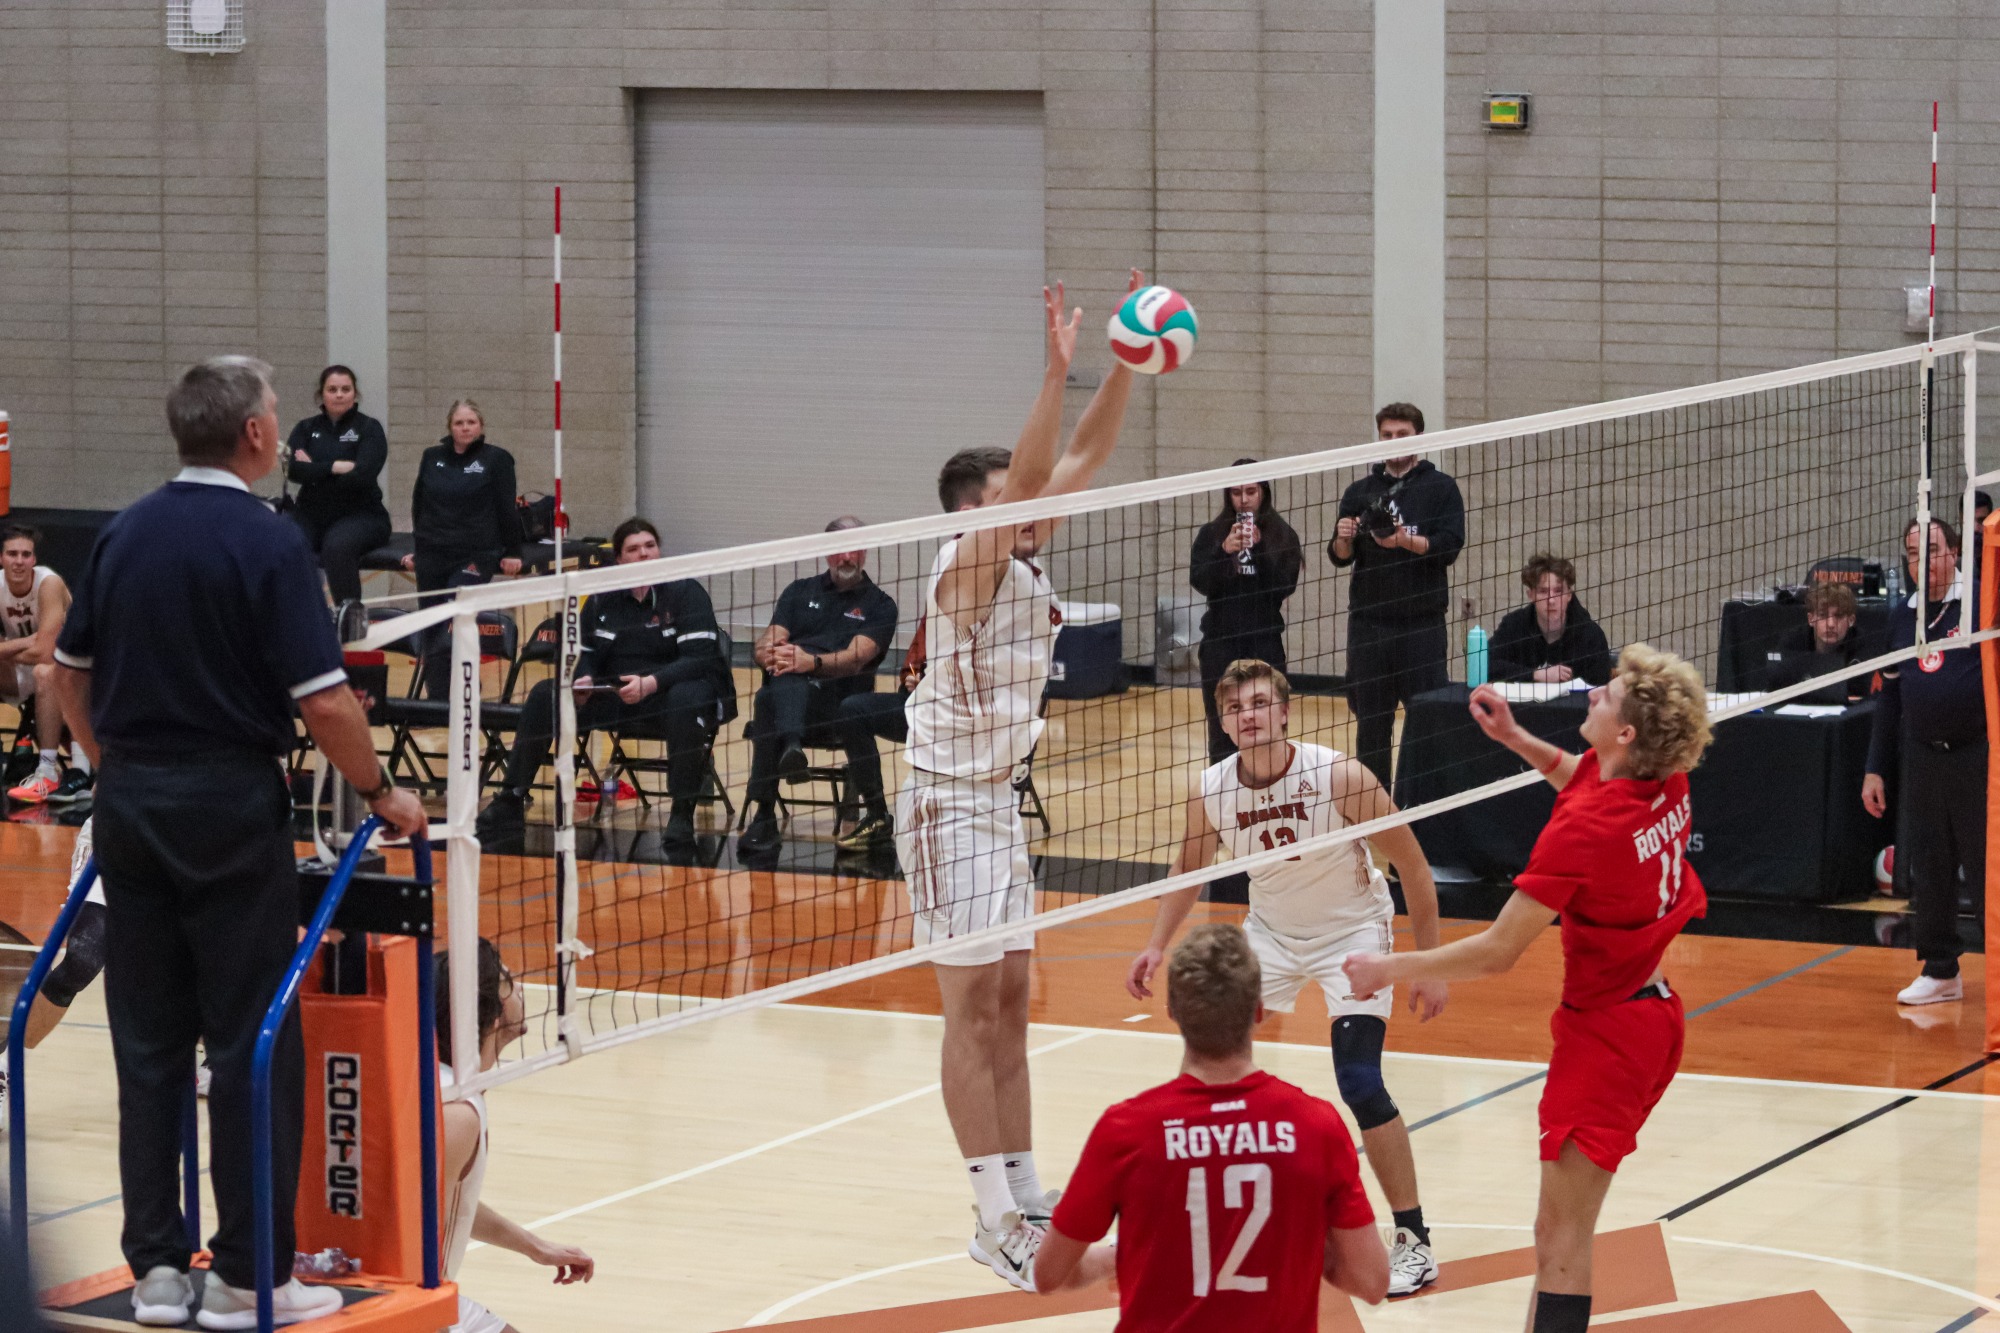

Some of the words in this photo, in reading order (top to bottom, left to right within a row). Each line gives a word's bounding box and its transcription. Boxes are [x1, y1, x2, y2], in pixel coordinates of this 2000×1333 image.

[327, 1056, 358, 1217] PORTER
[1163, 1120, 1296, 1160] ROYALS
[1185, 1163, 1273, 1298] 12
